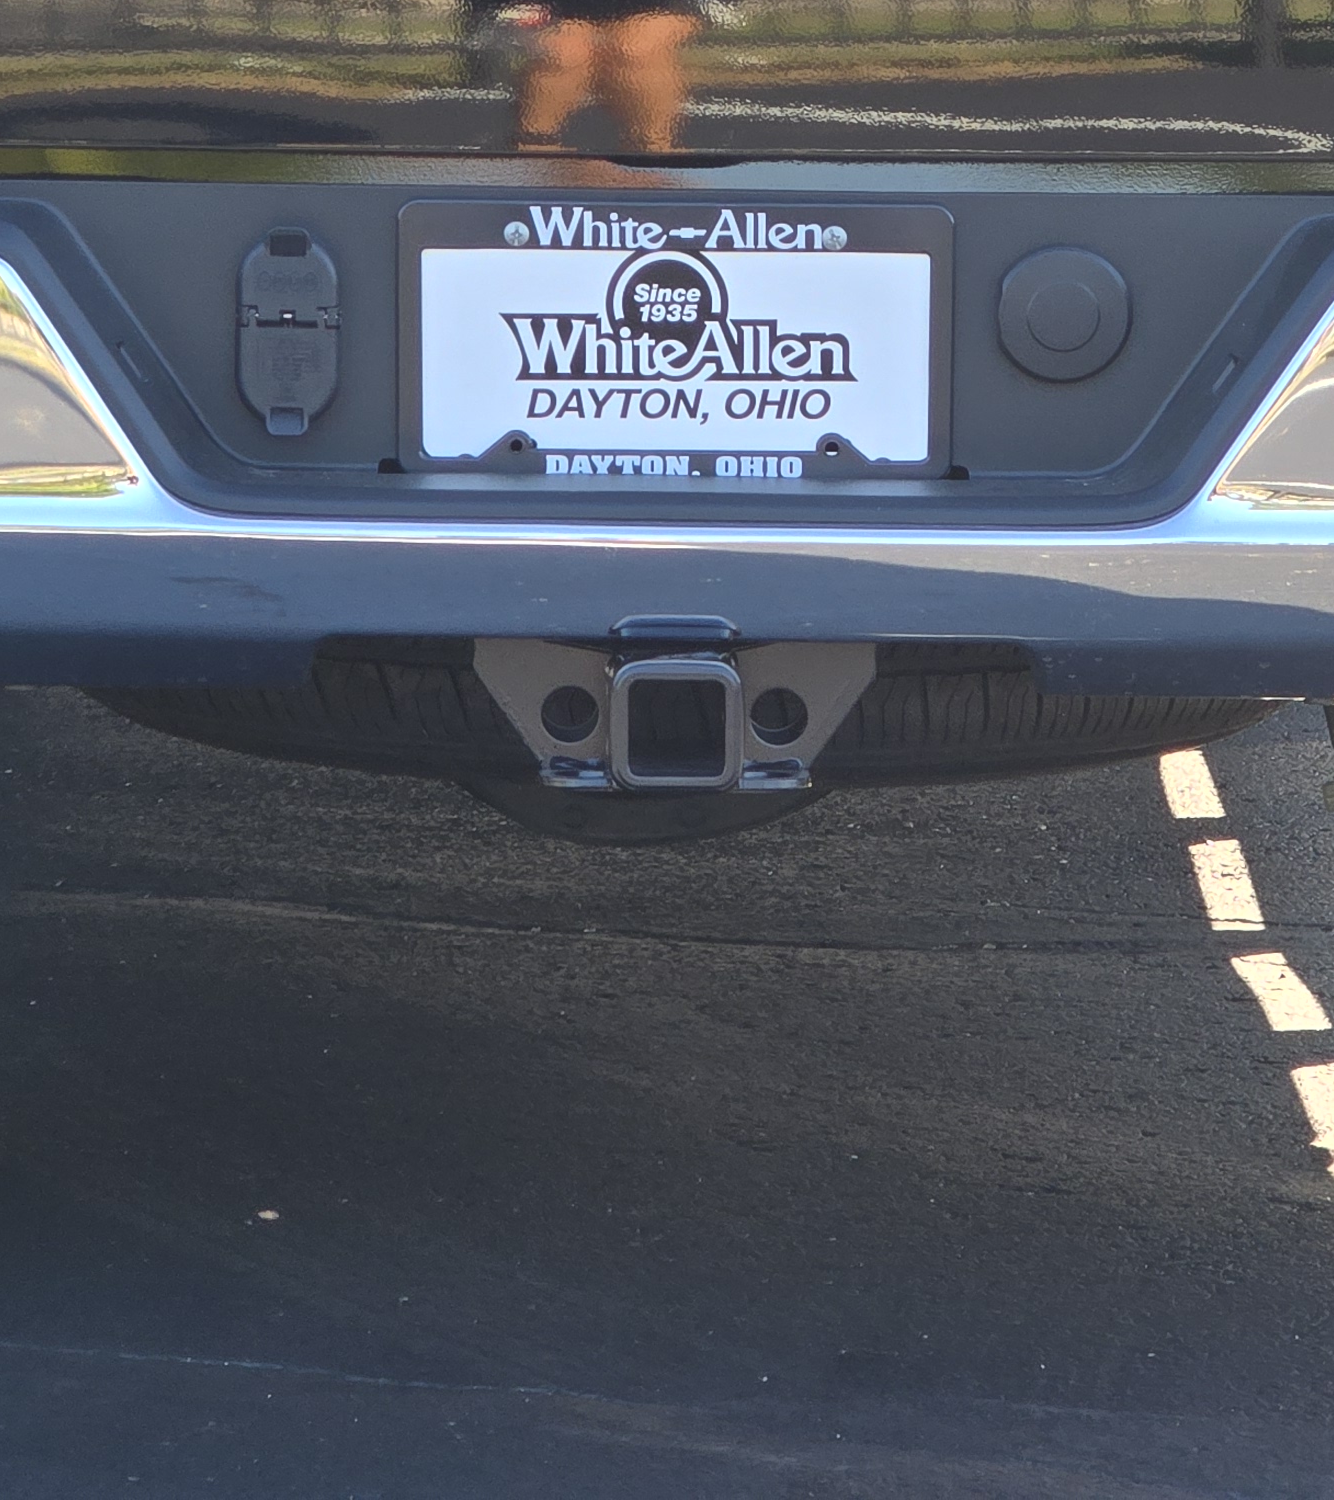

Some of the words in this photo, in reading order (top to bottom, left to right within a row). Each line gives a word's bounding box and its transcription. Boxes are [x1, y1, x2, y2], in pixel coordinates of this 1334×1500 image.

[633, 283, 702, 304] Since
[638, 303, 699, 323] 1935
[526, 388, 710, 426] DAYTON,
[724, 388, 832, 420] OHIO
[715, 455, 804, 479] OHIO
